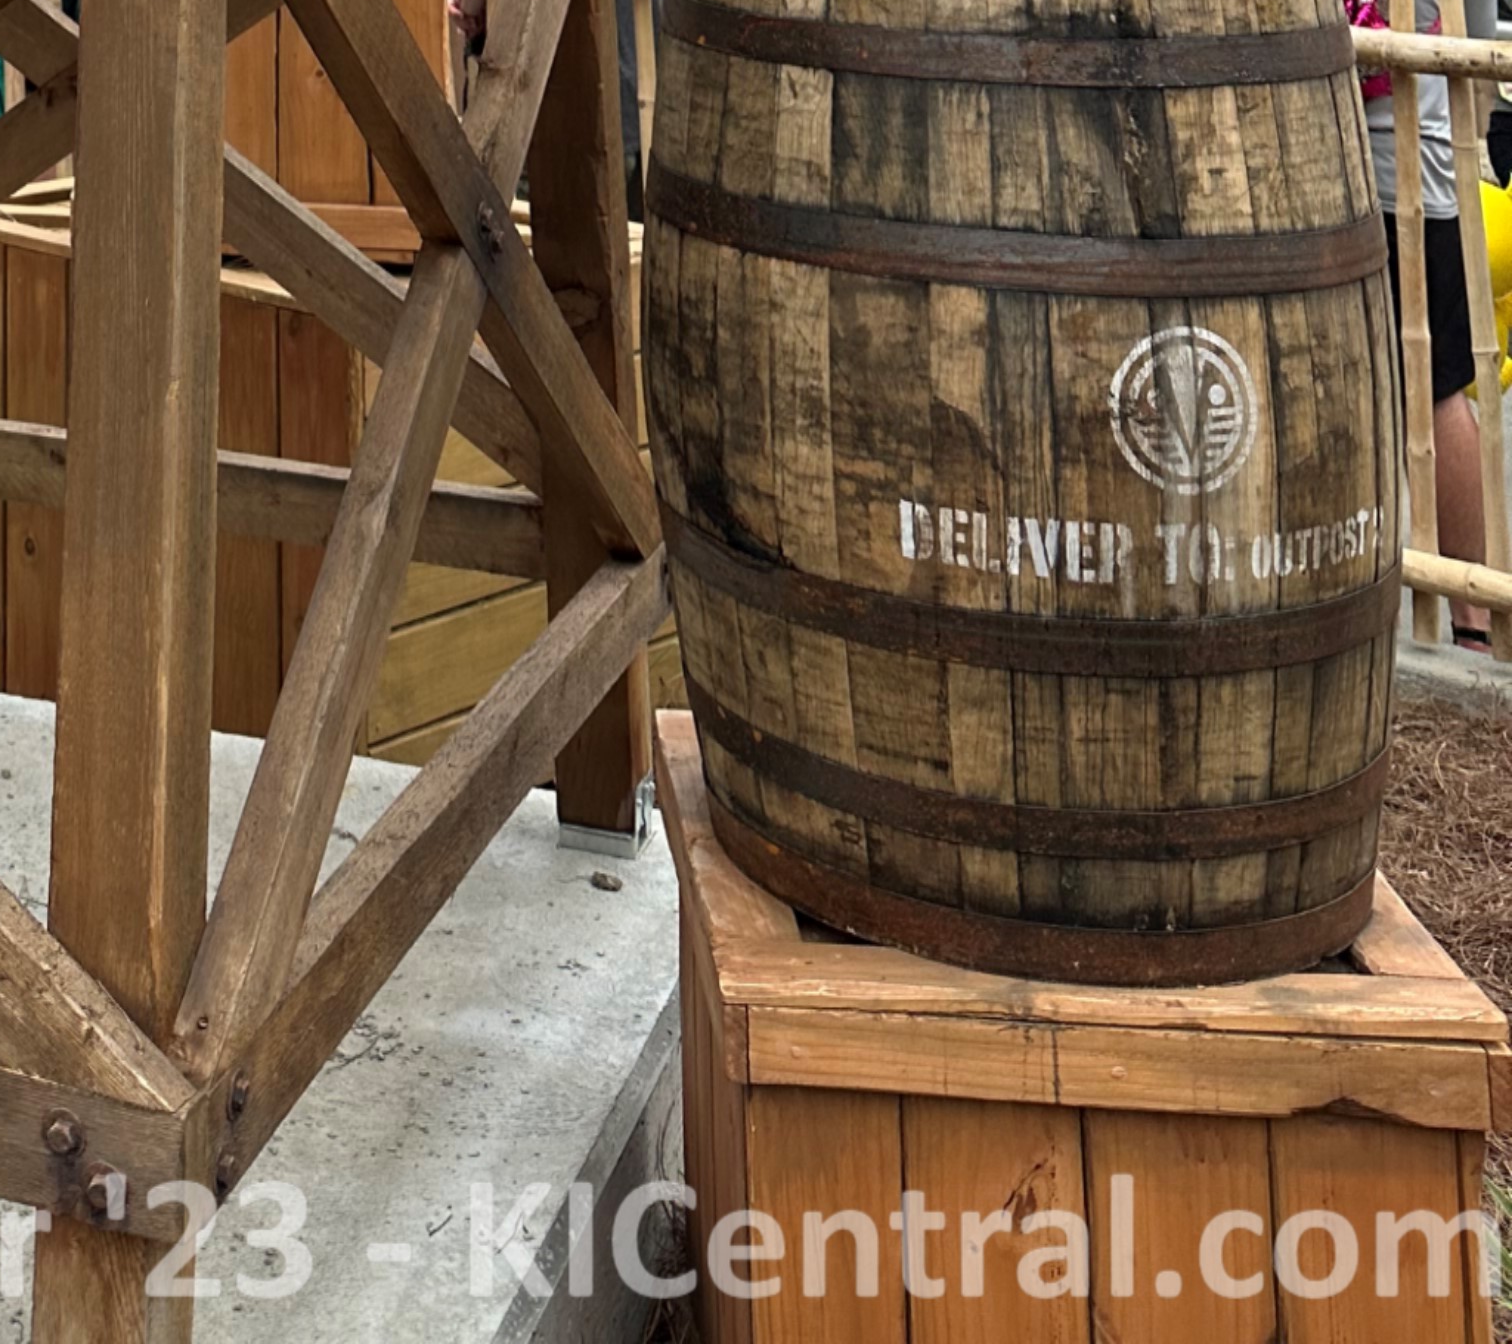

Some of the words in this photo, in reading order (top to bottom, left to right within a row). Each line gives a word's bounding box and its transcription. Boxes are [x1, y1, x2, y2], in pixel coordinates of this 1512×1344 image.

[899, 498, 1133, 584] DELIVER
[1154, 522, 1235, 585] TO:
[1251, 507, 1369, 580] OUTPOST
